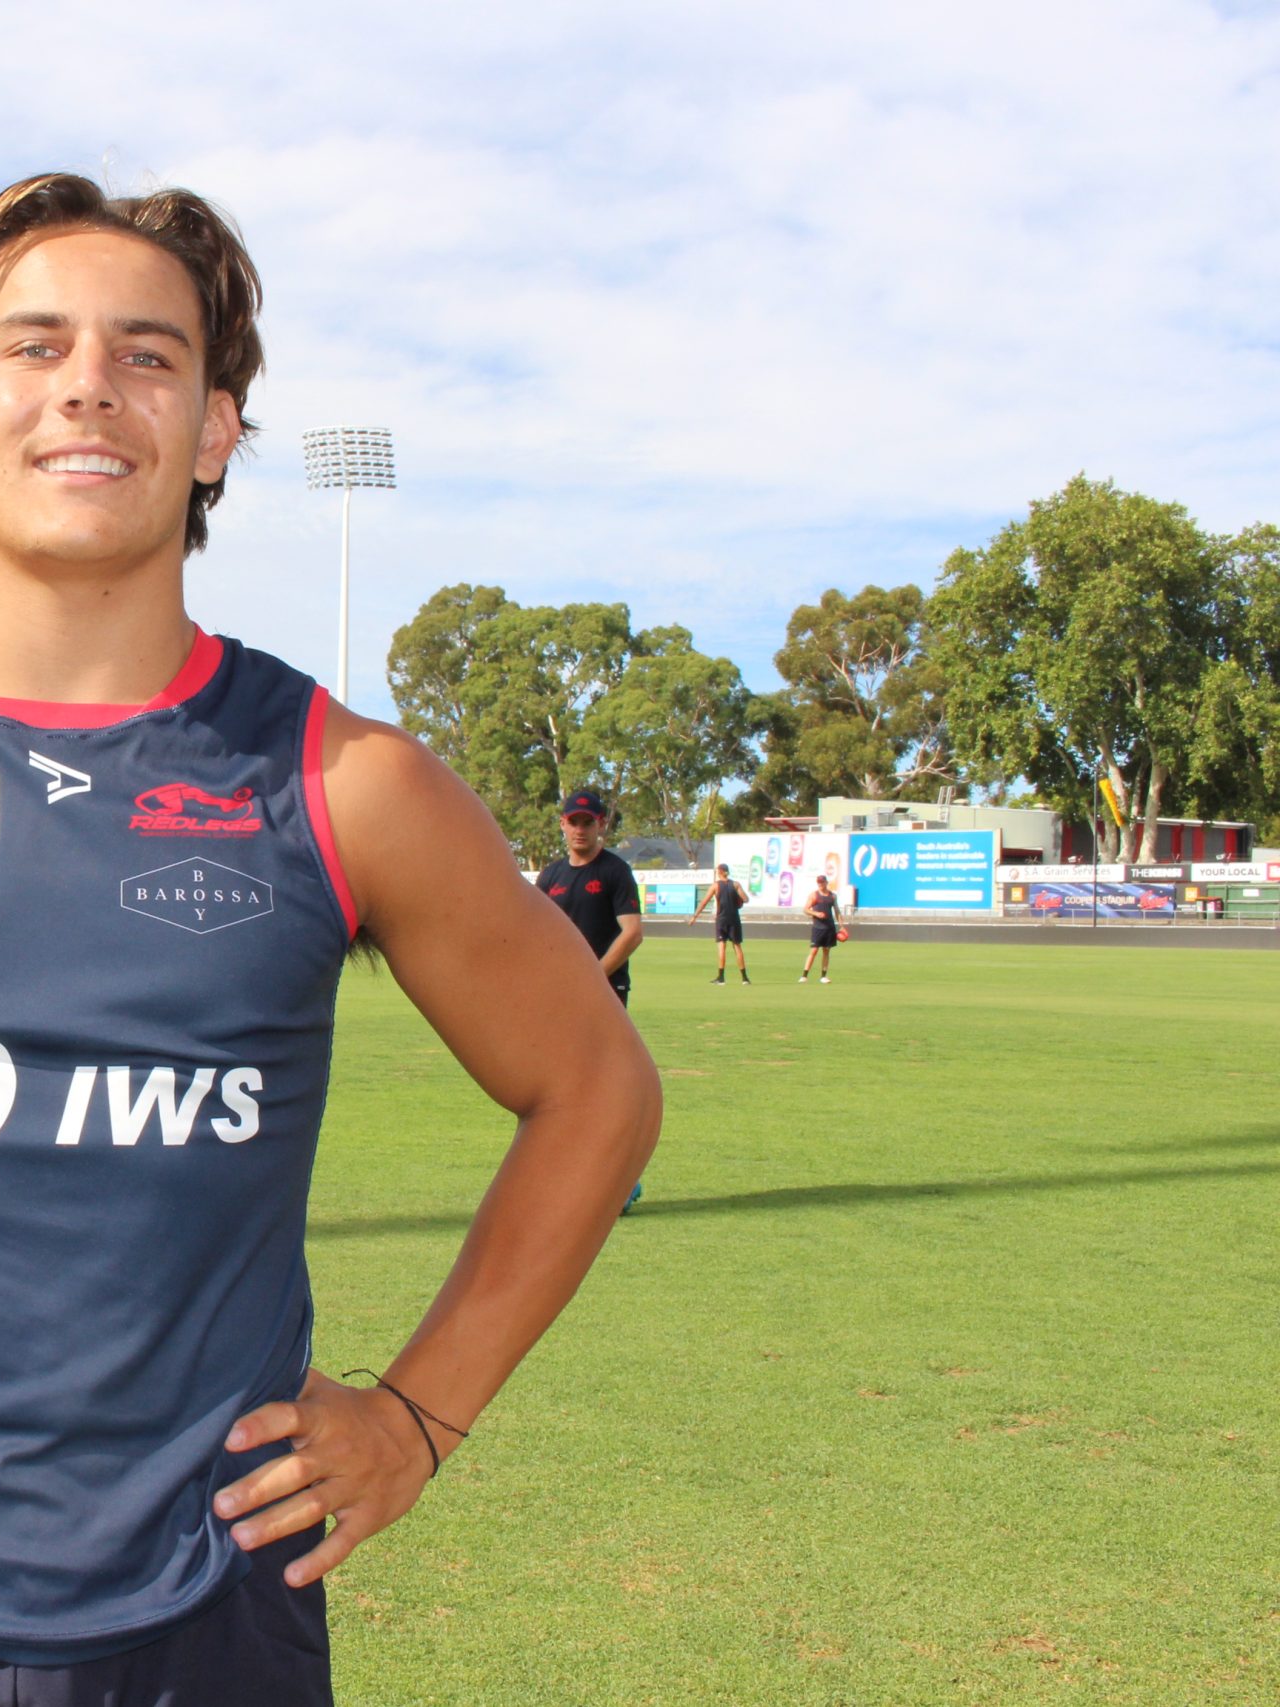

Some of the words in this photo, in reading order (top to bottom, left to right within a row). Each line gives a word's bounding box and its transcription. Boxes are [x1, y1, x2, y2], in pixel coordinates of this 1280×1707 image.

[128, 815, 263, 832] REDLEGS
[880, 853, 909, 870] IWS
[1043, 866, 1069, 876] Grain
[1072, 865, 1111, 876] Servces
[1200, 868, 1225, 876] YOUR
[1228, 868, 1260, 876] LOCAL
[136, 887, 260, 904] BAROSSA
[55, 1065, 264, 1146] IWS
